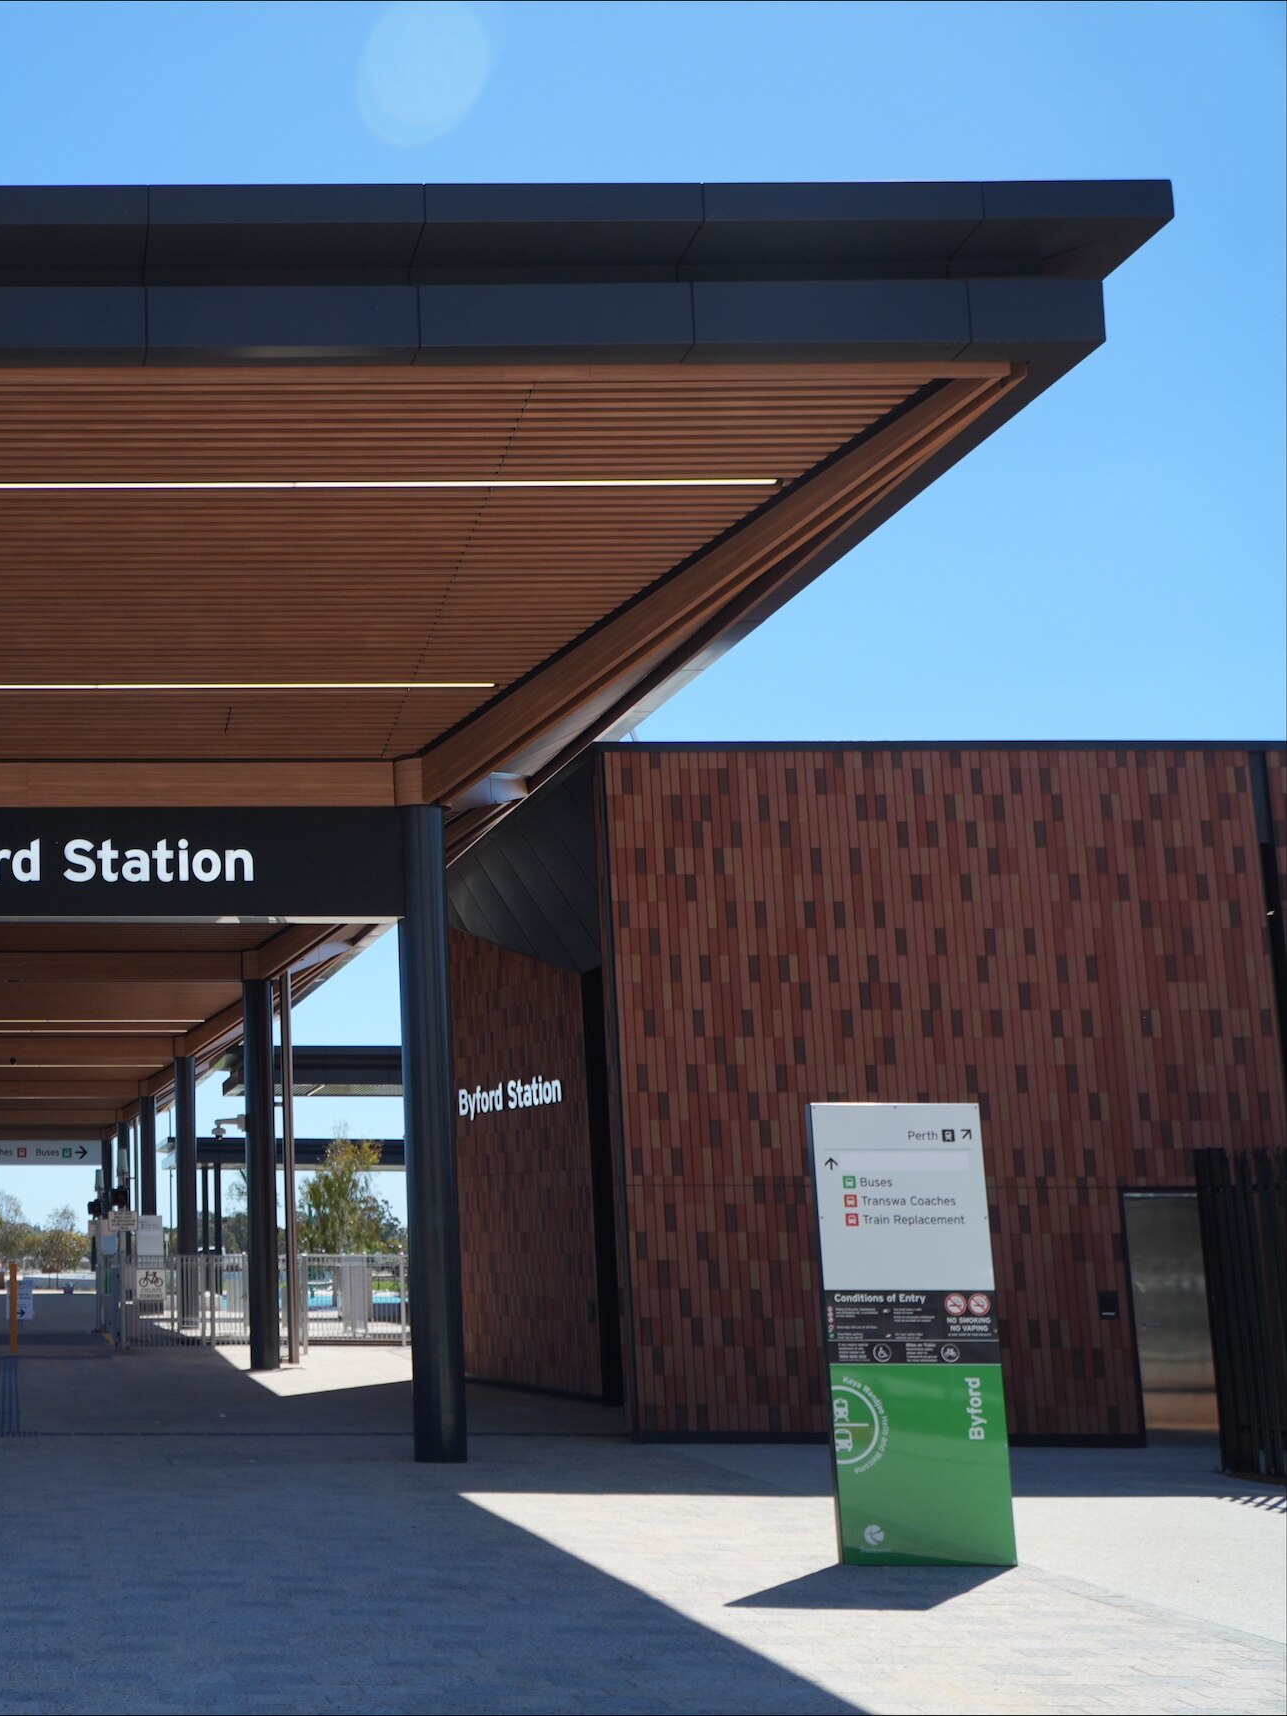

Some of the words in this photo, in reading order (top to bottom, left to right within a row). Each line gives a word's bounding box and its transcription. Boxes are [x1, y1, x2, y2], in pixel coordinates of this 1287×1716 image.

[62, 838, 255, 882] Station
[458, 1082, 504, 1121] Byford
[507, 1075, 563, 1110] Station
[907, 1130, 938, 1141] Perth
[35, 1147, 60, 1157] Buses
[859, 1177, 893, 1188] Buses
[861, 1196, 907, 1206] Transwa
[909, 1196, 957, 1206] Coaches
[862, 1215, 890, 1225] Train
[893, 1215, 966, 1227] Replacement
[833, 1293, 885, 1303] Conditions
[886, 1293, 896, 1303] of
[898, 1293, 927, 1304] Entry
[842, 1376, 862, 1389] Kaya
[862, 1385, 885, 1414] Wandjoo
[964, 1377, 987, 1440] Byford
[881, 1415, 889, 1436] Hello
[854, 1451, 884, 1474] Welcome
